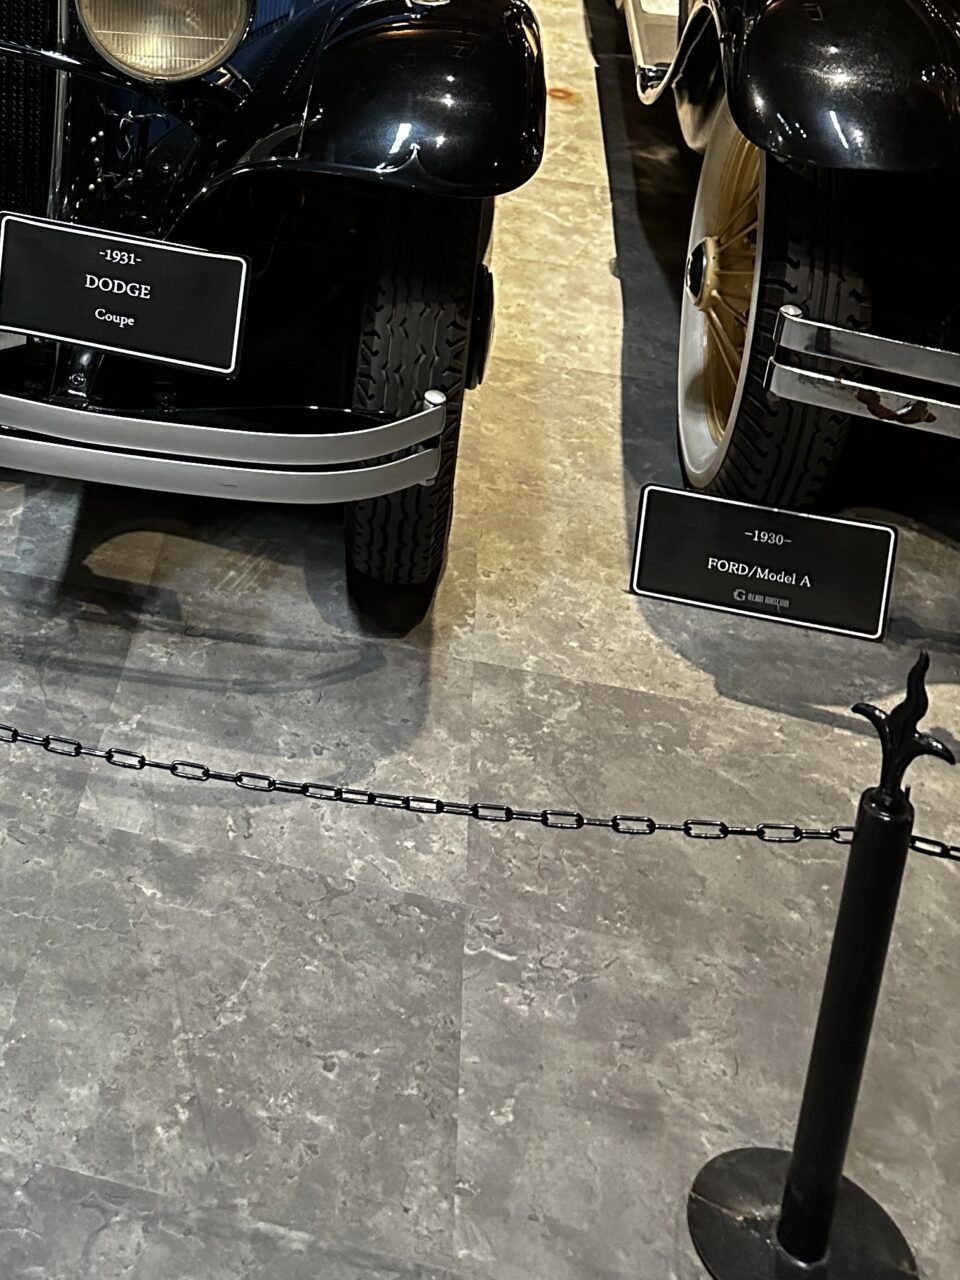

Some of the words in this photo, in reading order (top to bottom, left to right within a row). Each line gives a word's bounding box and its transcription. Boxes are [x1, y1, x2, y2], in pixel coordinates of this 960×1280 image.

[99, 249, 142, 264] -1931-
[85, 274, 151, 299] DODGE
[94, 308, 135, 328] Coupe
[707, 557, 796, 584] FORD/Model
[799, 575, 811, 587] A
